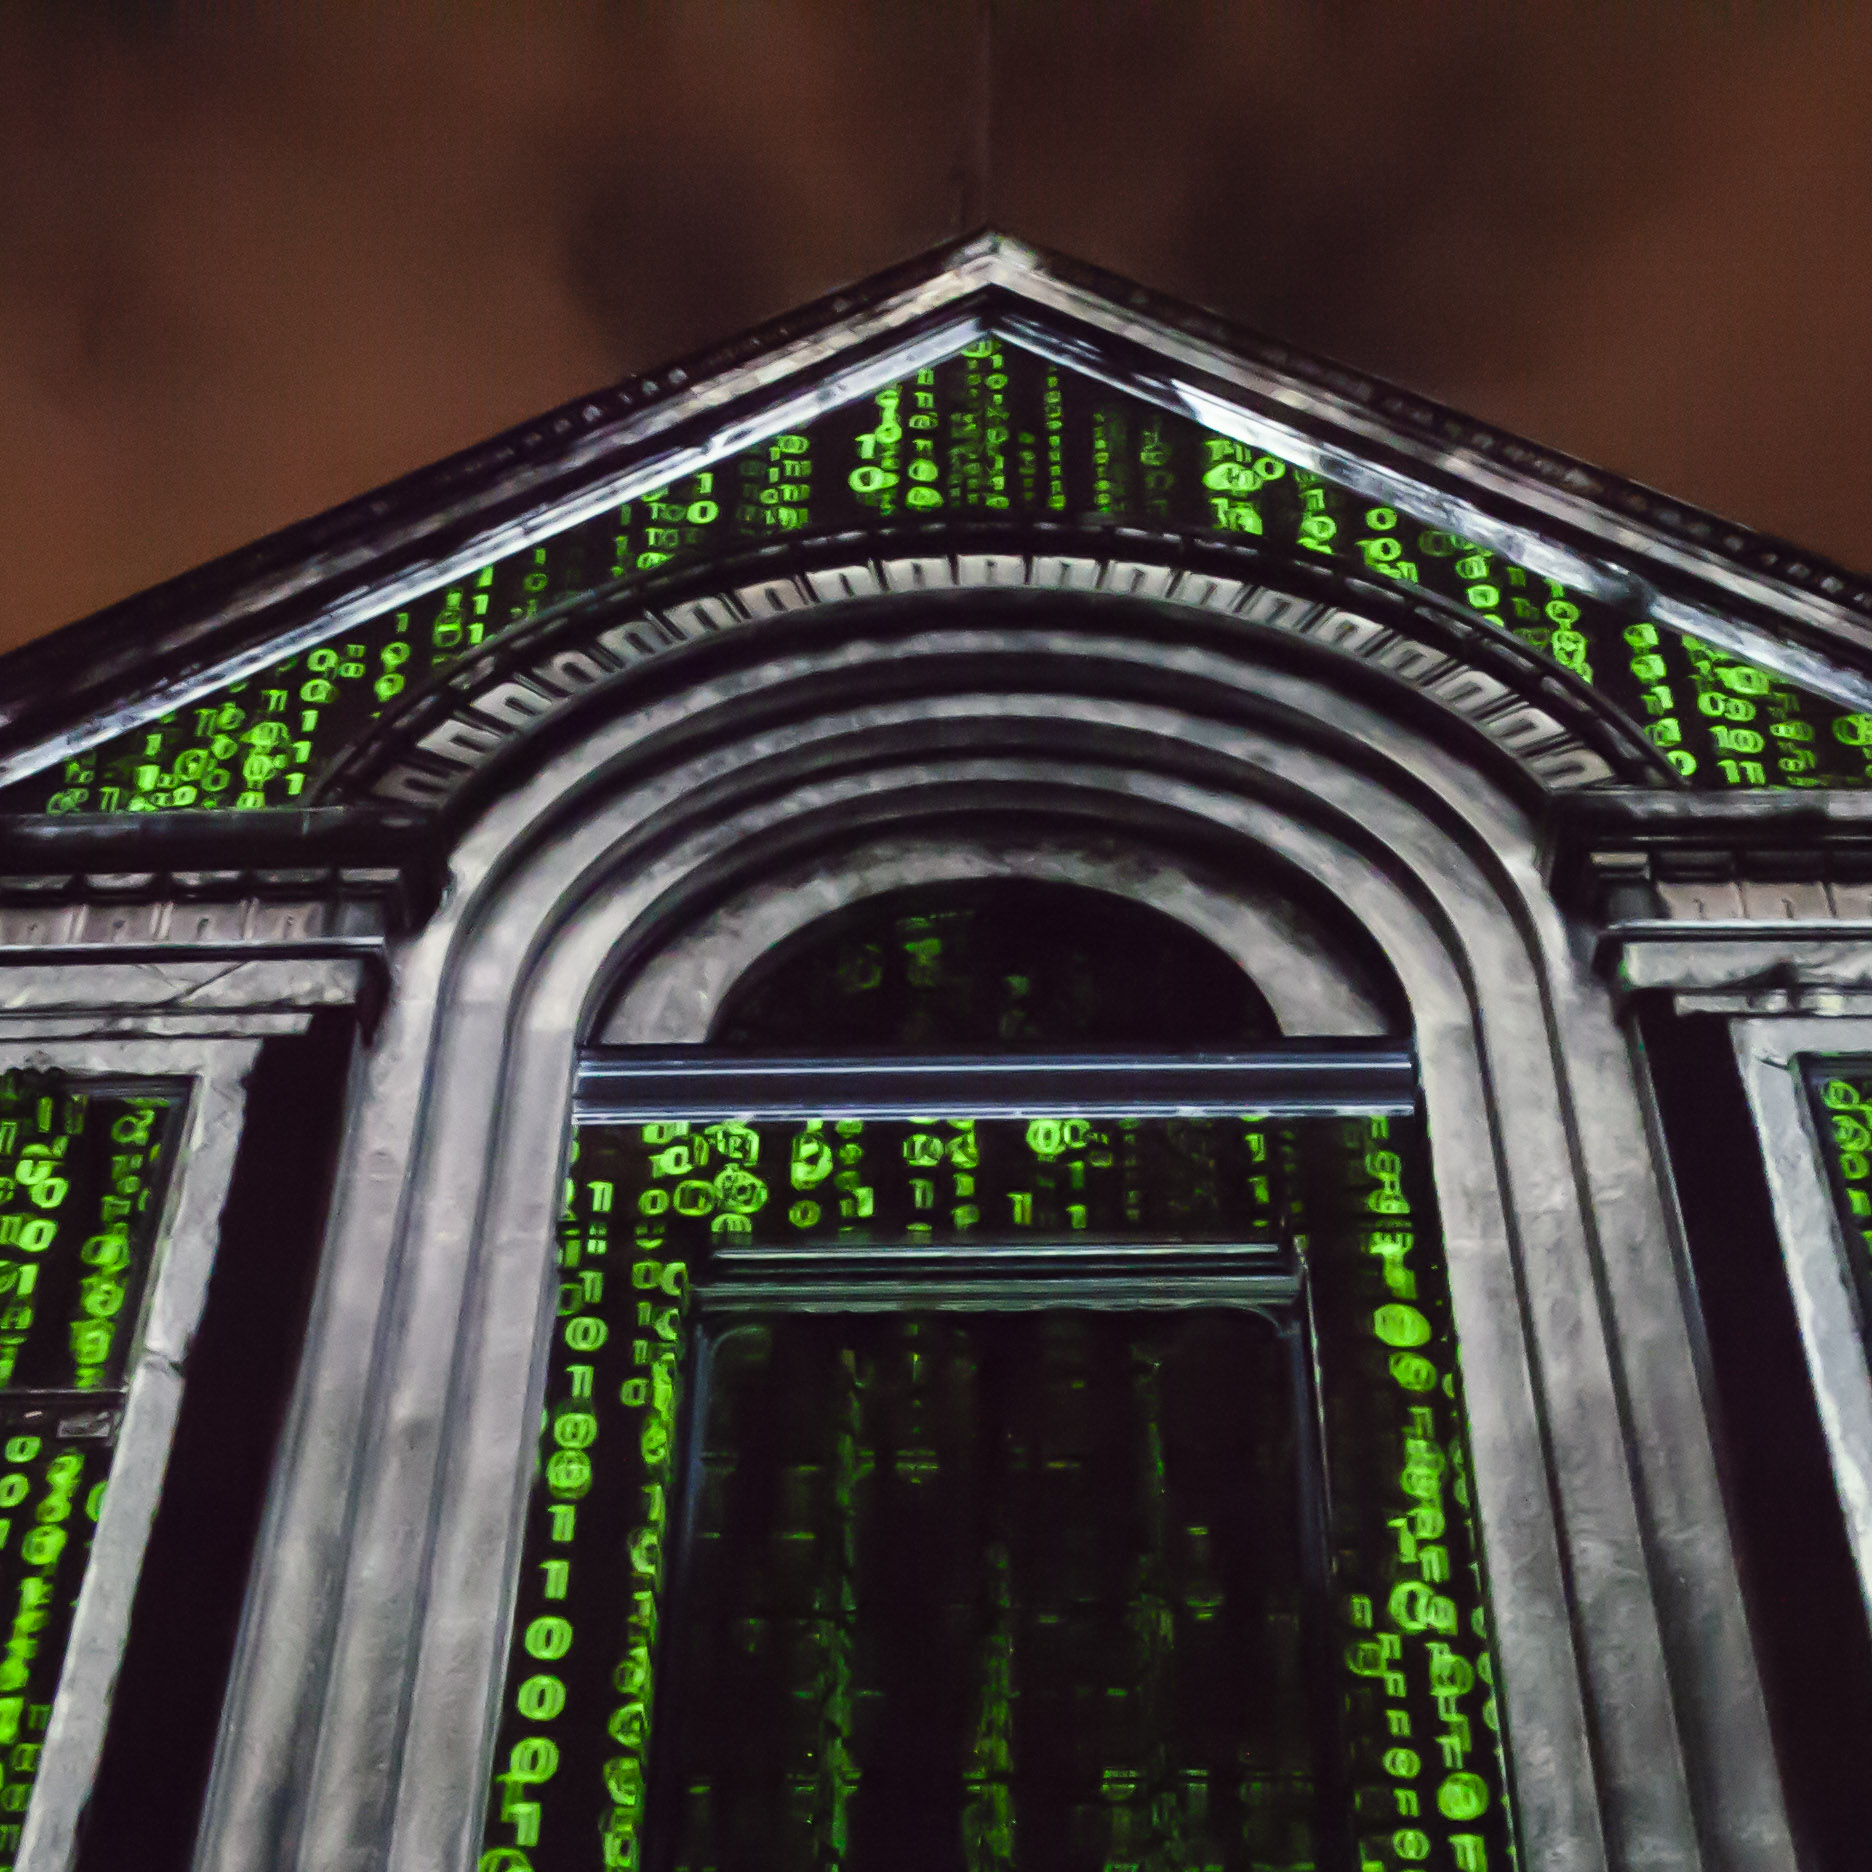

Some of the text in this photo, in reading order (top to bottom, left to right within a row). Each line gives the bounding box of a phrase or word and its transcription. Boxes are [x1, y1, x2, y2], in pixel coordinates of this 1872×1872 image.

[697, 472, 715, 495] 1
[468, 622, 484, 645] 1
[301, 709, 318, 732] 1
[294, 740, 313, 763] 1
[286, 772, 306, 795] 1
[548, 1504, 576, 1542] 1
[539, 1559, 570, 1600] 1
[512, 1802, 541, 1847] 1
